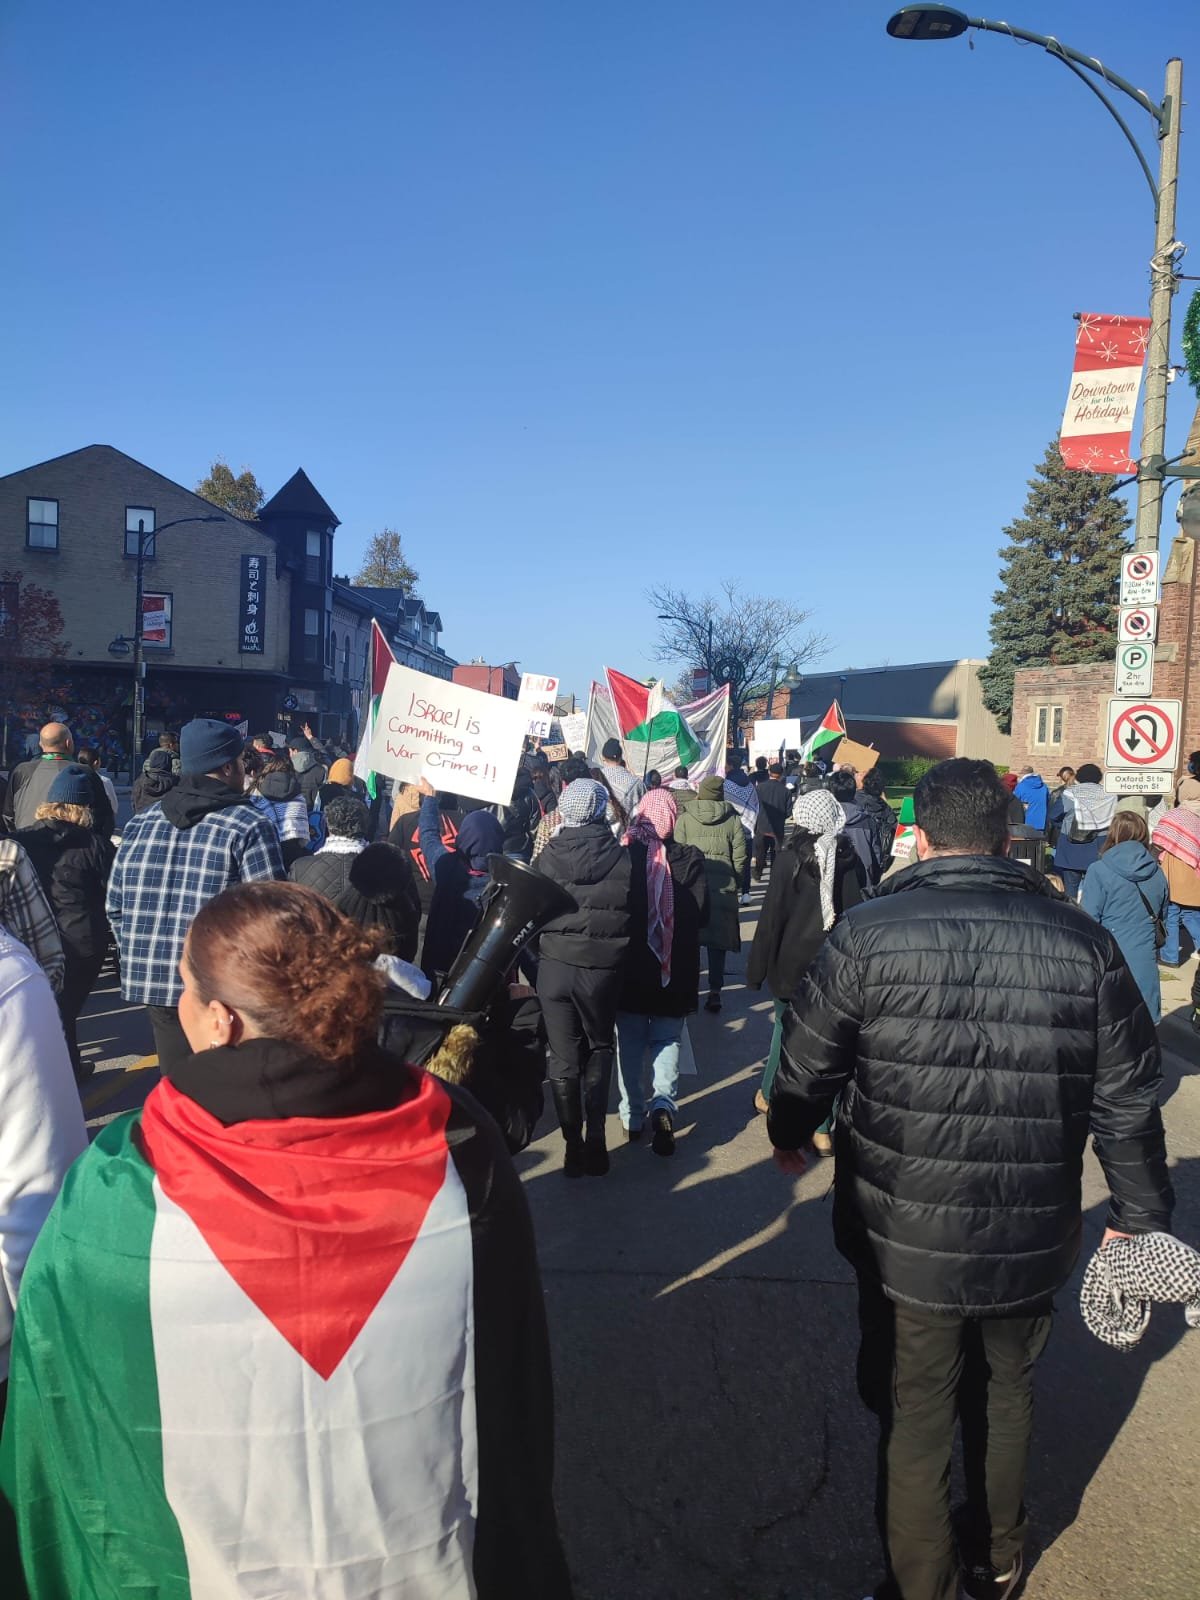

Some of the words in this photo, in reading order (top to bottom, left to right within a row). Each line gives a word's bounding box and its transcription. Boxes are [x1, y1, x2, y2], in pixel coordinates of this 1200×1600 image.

[1072, 381, 1135, 400] Downtown
[1074, 405, 1130, 423] Holidays
[1130, 652, 1142, 665] P
[466, 715, 481, 735] is
[388, 716, 464, 757] Committing
[472, 745, 482, 753] a
[386, 740, 420, 759] War
[512, 919, 535, 946] PYLE
